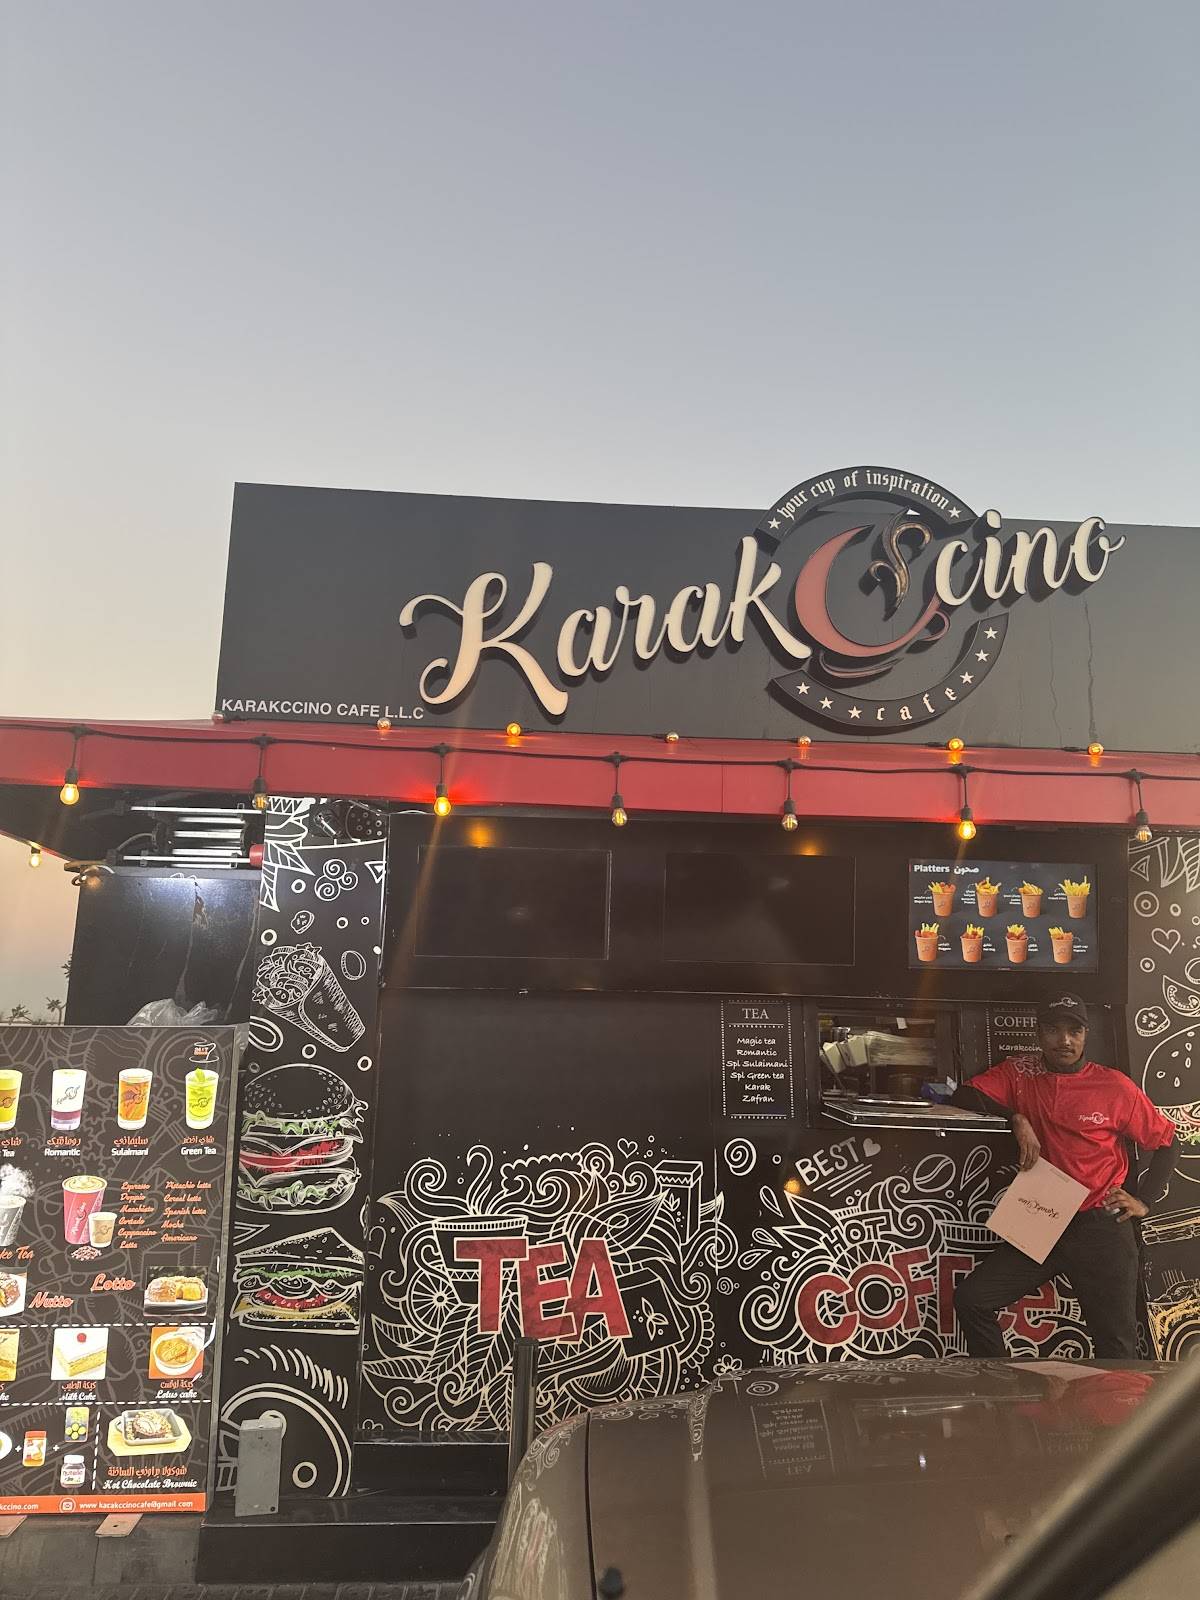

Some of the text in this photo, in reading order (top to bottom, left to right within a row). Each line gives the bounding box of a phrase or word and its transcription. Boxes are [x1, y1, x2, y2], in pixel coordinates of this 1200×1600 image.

[777, 469, 949, 520] your cup of inspiration
[221, 699, 424, 720] KARAKCCINO CAFE L.L.C
[876, 687, 958, 721] cafe
[913, 864, 950, 873] Platters
[742, 1008, 769, 1020] TEA
[737, 1036, 762, 1047] Magic
[736, 1047, 777, 1056] Romantic
[726, 1059, 788, 1070] Spl Sulaimani
[730, 1071, 785, 1081] Spl Green tea
[744, 1083, 771, 1091] Karak
[742, 1094, 775, 1104] Zafran
[2, 1149, 15, 1157] Tea
[44, 1148, 81, 1156] Romantic
[181, 1146, 216, 1155] Green Tea
[795, 1136, 858, 1186] BEST
[819, 1215, 888, 1264] HOT
[16, 1245, 34, 1260] Tea
[90, 1273, 136, 1292] Lotto
[454, 1236, 632, 1344] TEA
[28, 1291, 74, 1308] Nutto
[79, 1392, 96, 1401] Cake
[155, 1389, 197, 1399] Lotus cake
[121, 1479, 161, 1489] Chocolate
[162, 1479, 198, 1489] Brownie
